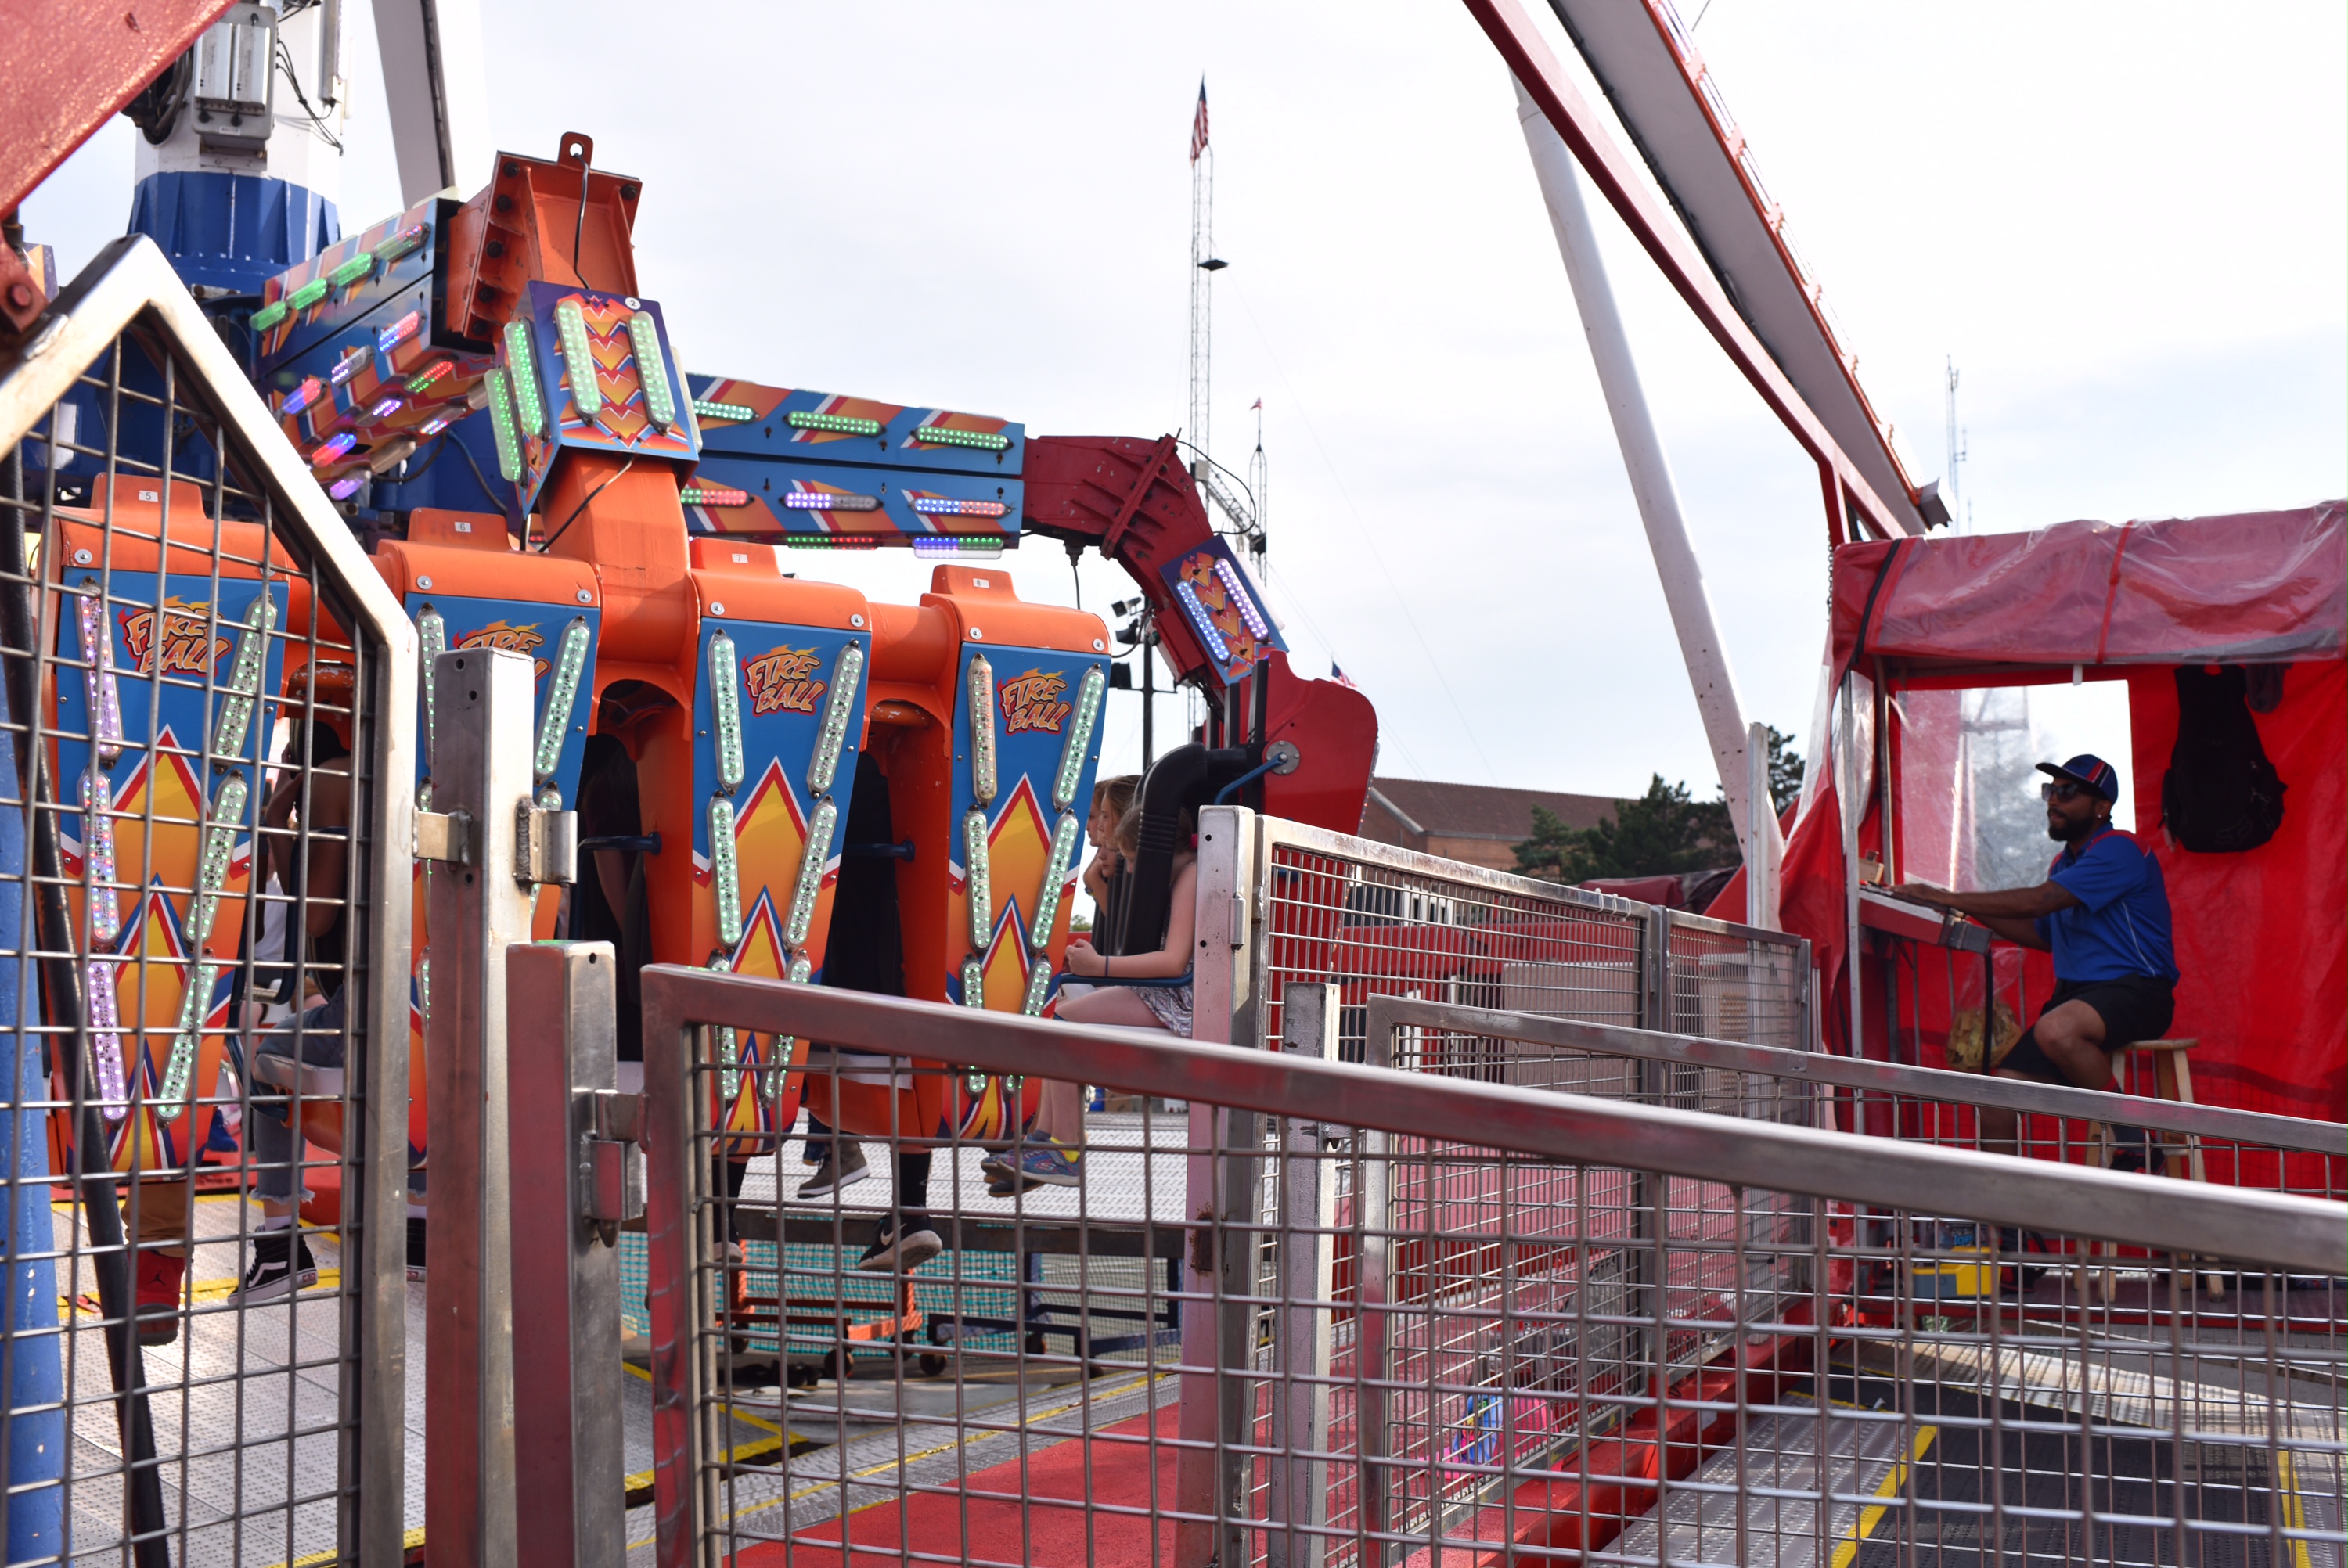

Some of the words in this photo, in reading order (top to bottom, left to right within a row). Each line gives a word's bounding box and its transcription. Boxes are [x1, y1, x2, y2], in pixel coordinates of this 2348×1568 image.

[145, 492, 152, 501] 5
[459, 523, 466, 531] 6
[746, 653, 821, 697] FIRE
[755, 681, 825, 714] BALL
[1001, 677, 1067, 717] FIRE
[1008, 702, 1070, 732] BALL
